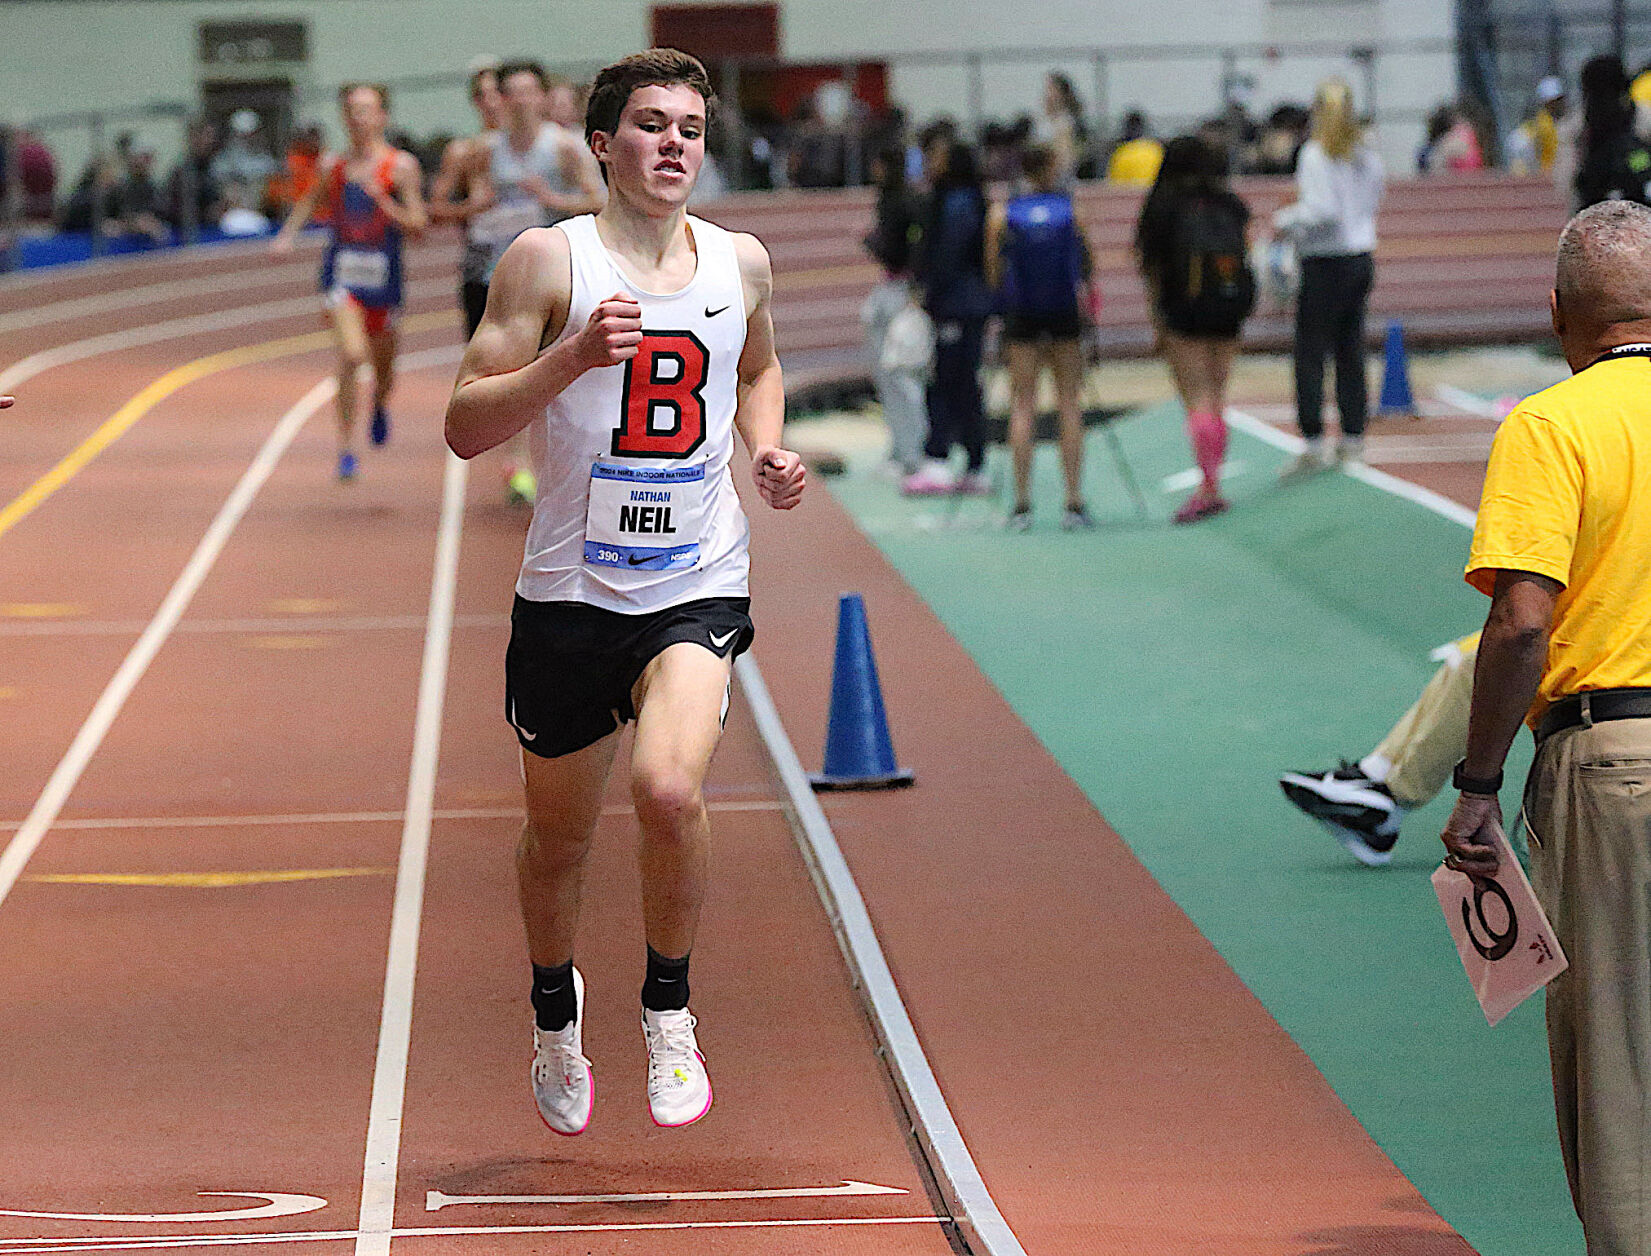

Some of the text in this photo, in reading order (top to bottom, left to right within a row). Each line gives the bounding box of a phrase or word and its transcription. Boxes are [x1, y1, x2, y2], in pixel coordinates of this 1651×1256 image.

[611, 330, 710, 460] B
[617, 468, 634, 477] NIKE
[636, 471, 664, 479] INDOOR
[630, 490, 671, 502] NATHAN
[619, 505, 677, 534] NEIL
[597, 549, 619, 563] 390
